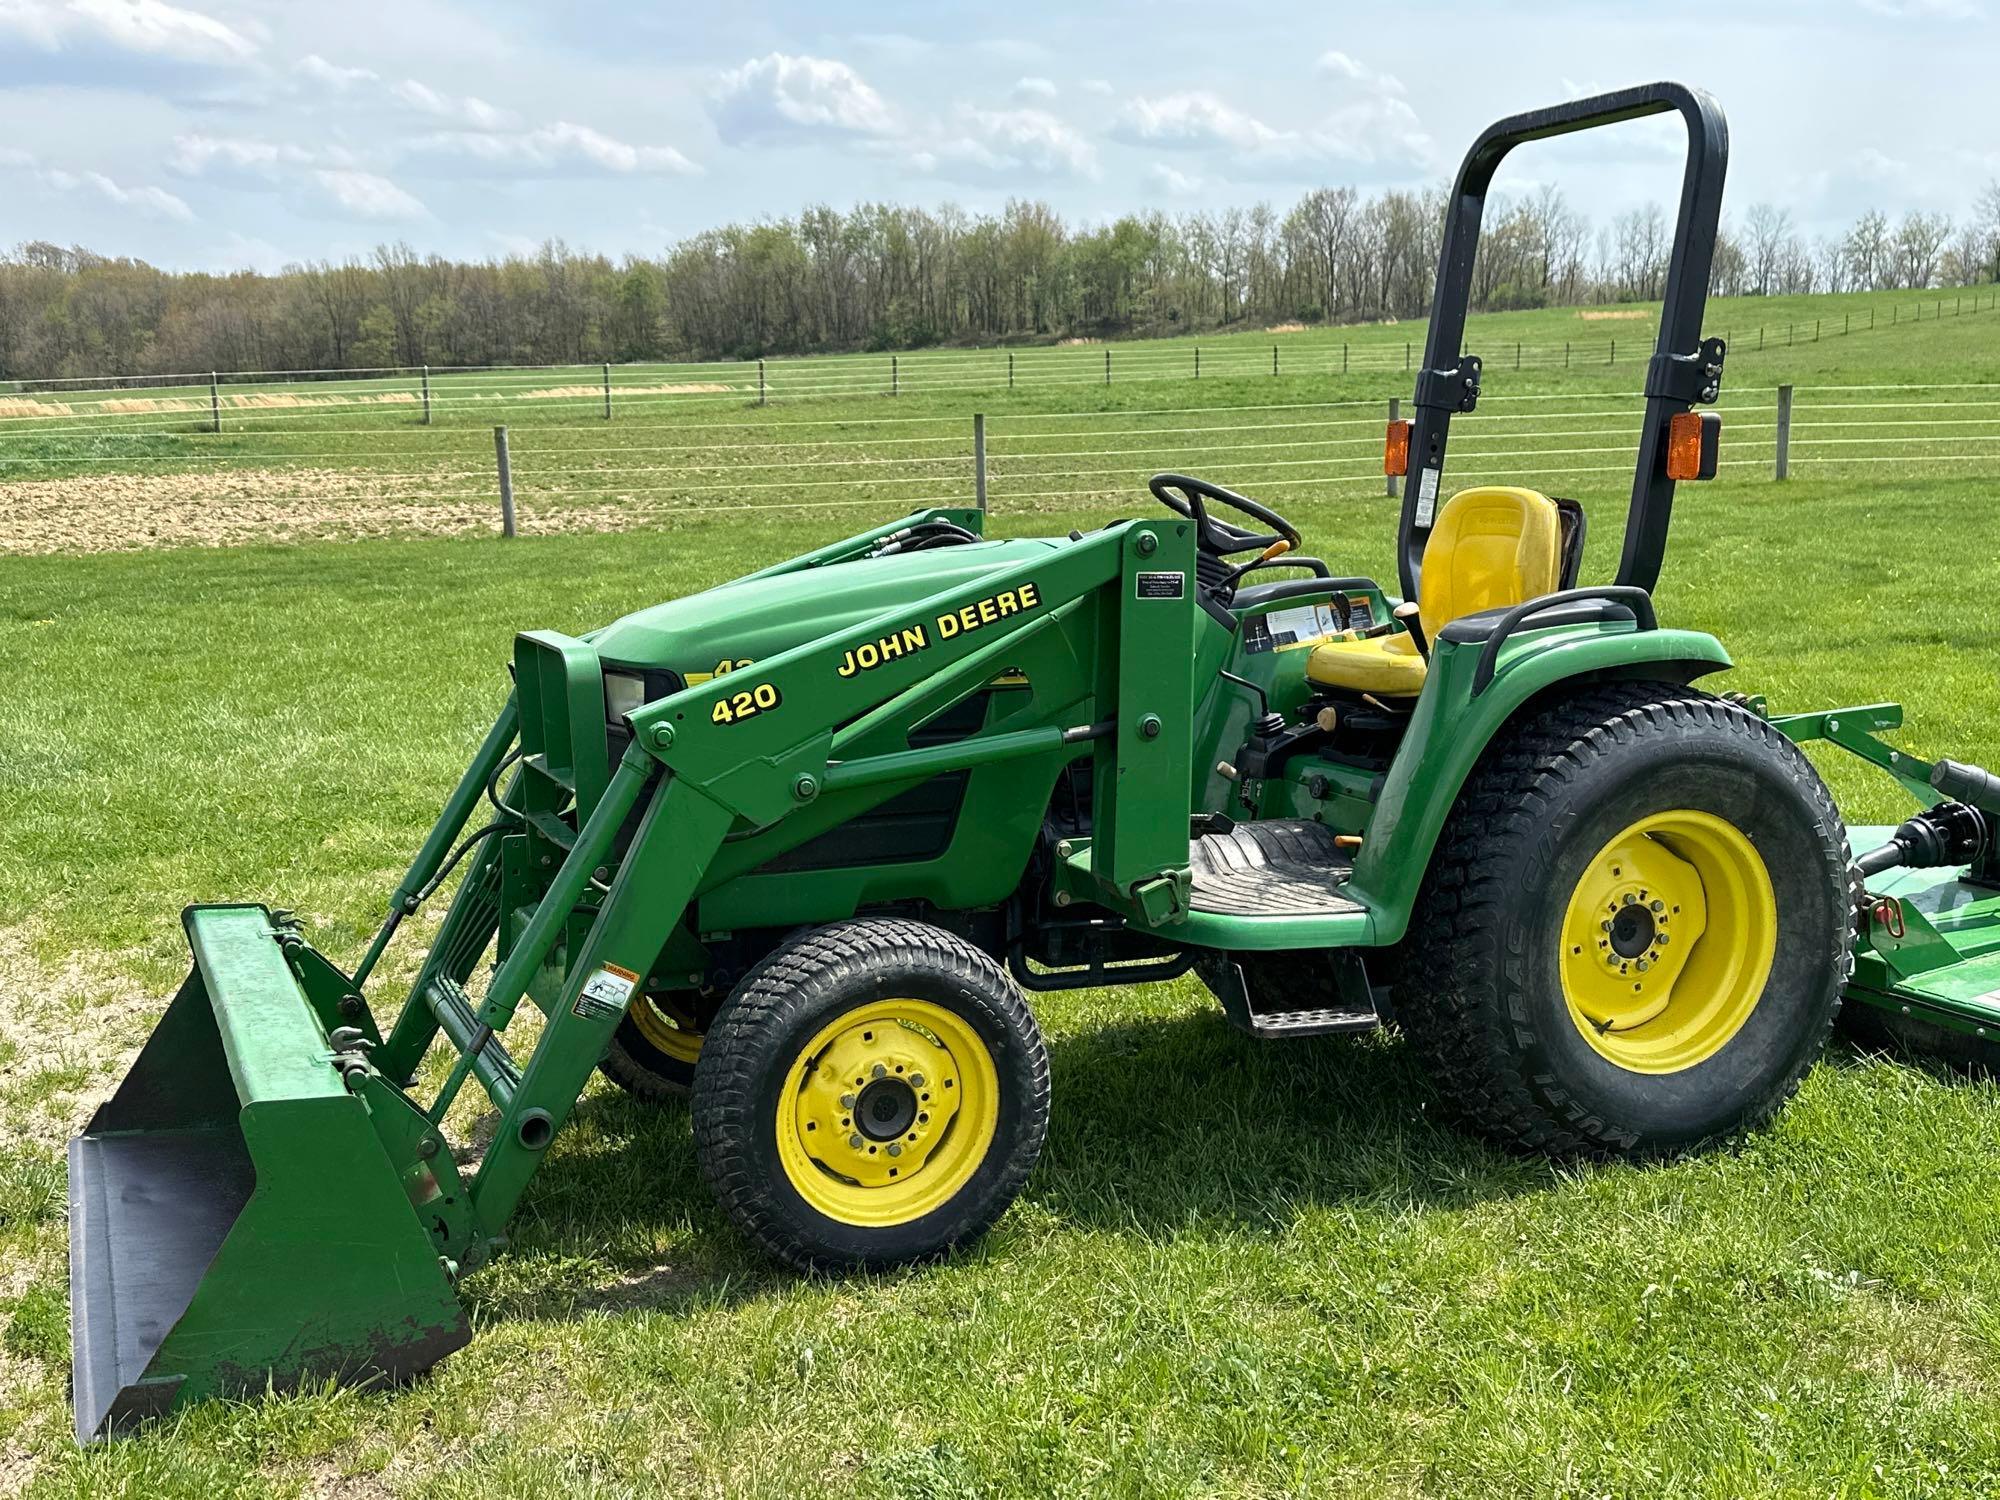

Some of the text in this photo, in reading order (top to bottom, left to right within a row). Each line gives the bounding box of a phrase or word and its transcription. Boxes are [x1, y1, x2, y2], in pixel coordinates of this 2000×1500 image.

[837, 583, 1040, 677] JOHN DEERE
[711, 683, 779, 724] 420
[1505, 921, 1537, 1049] TRAC
